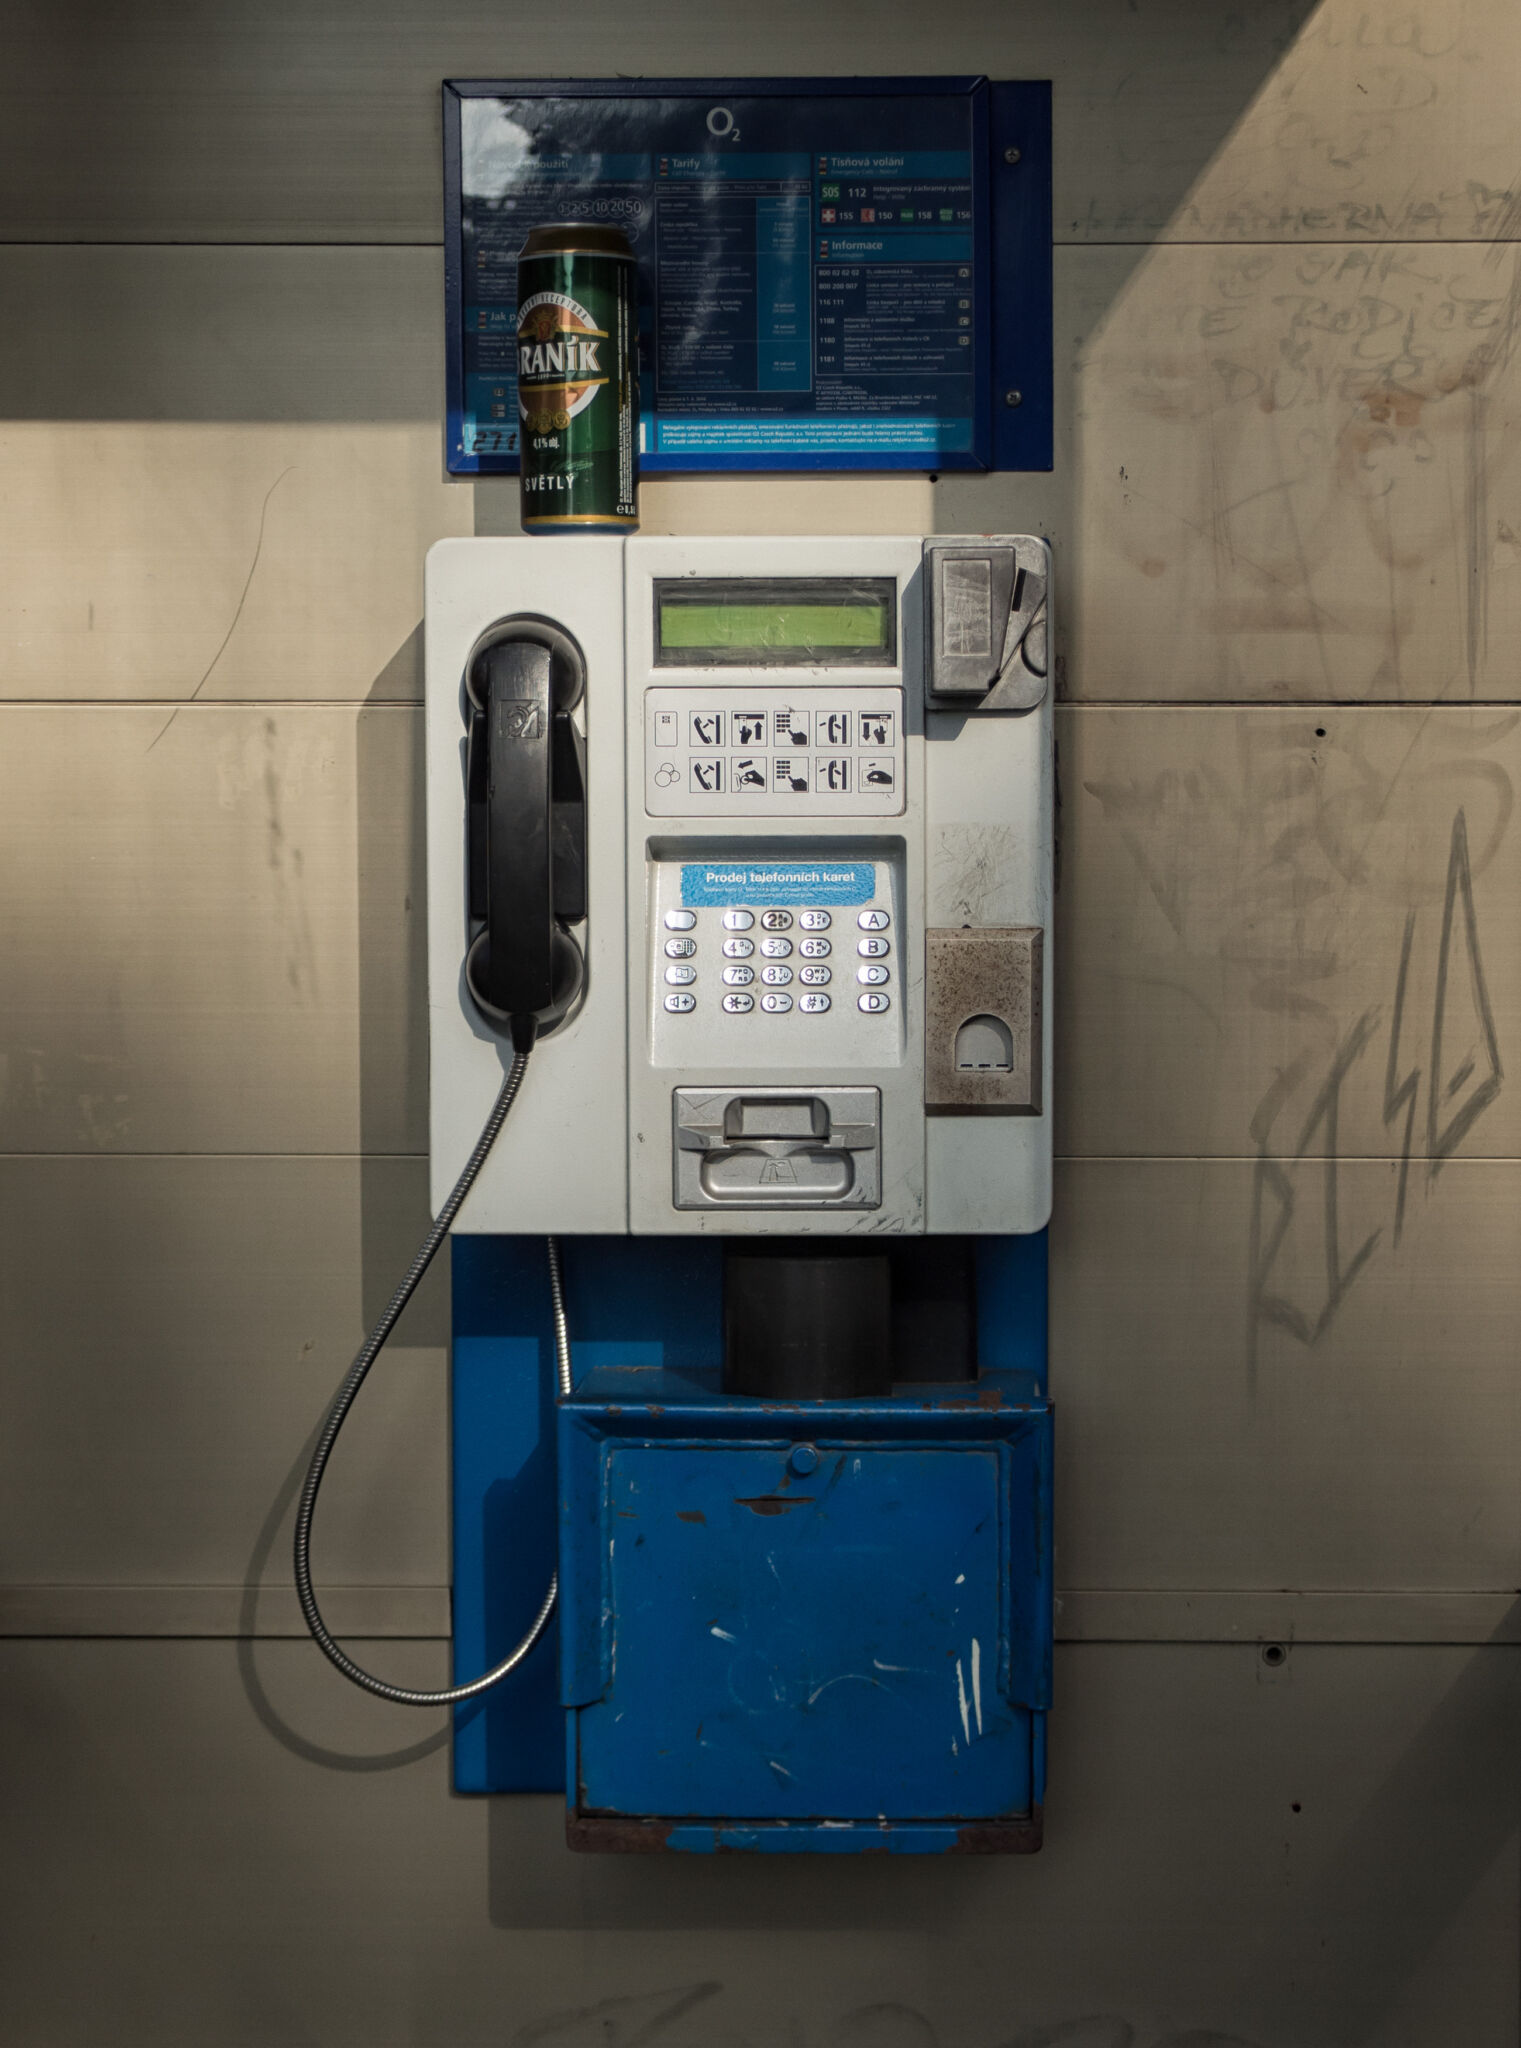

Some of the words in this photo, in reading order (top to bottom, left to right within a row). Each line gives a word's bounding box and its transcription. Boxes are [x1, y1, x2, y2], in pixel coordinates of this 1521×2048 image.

[706, 106, 742, 142] O2
[672, 158, 701, 170] Tarify
[873, 156, 905, 167] volání
[822, 186, 840, 198] SOS
[848, 188, 867, 198] 112
[625, 200, 642, 213] 50
[840, 211, 855, 220] 155
[878, 211, 894, 220] 150
[918, 211, 933, 220] 158
[832, 240, 883, 251] Informace
[490, 311, 507, 321] Jak
[520, 335, 602, 376] RANÍK
[525, 472, 575, 492] SVĚTLÝ
[706, 872, 747, 884] Prodej
[750, 871, 820, 883] telefonních
[823, 872, 856, 882] karet
[768, 913, 777, 927] 2
[806, 913, 815, 927] 3
[868, 913, 880, 927] A
[728, 941, 737, 954] 4
[767, 941, 775, 954] 5
[806, 941, 814, 954] 6
[868, 940, 879, 954] B
[731, 969, 738, 981] 7
[767, 968, 776, 981] 8
[805, 968, 814, 981] 9
[867, 967, 879, 981] C
[767, 996, 777, 1009] 0
[868, 995, 880, 1009] D
